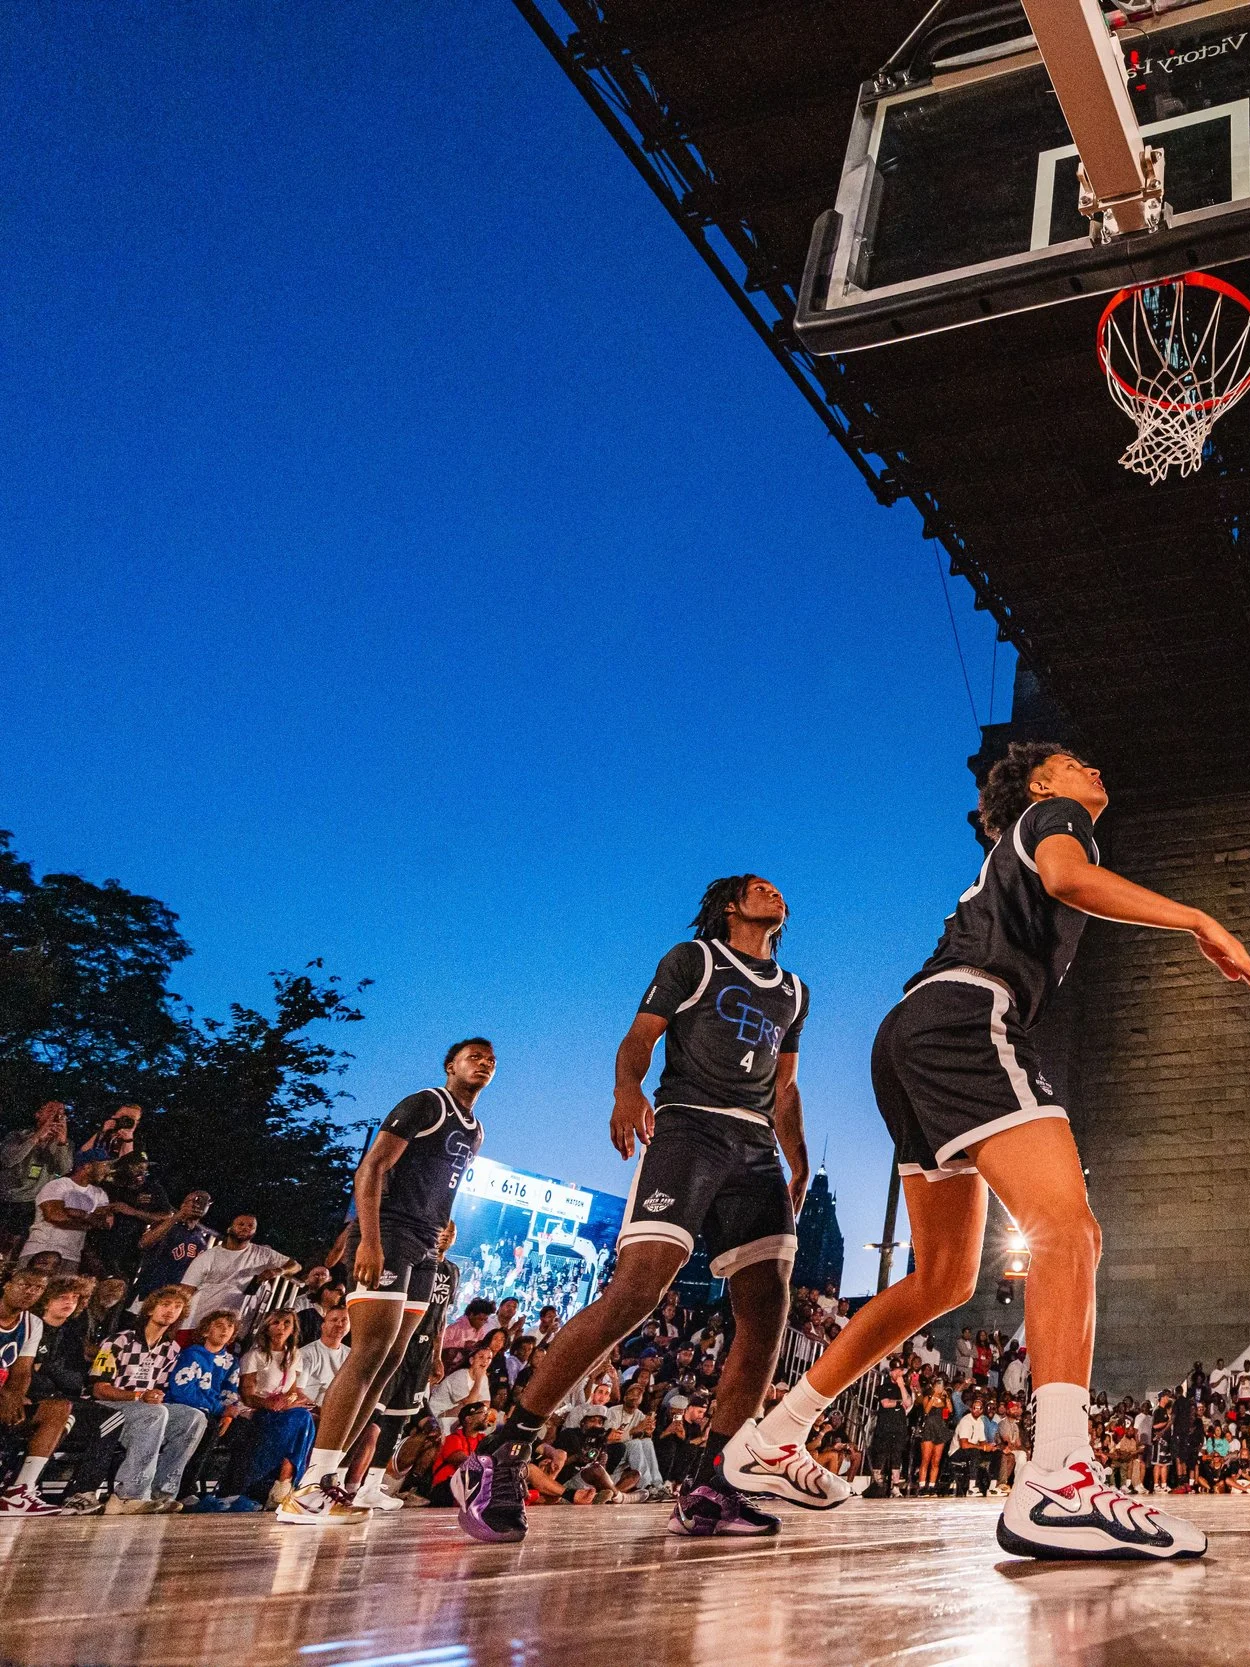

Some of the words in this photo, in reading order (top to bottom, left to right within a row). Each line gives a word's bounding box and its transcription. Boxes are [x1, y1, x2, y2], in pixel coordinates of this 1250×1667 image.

[740, 1050, 755, 1073] 4
[448, 1172, 460, 1189] 5
[501, 1179, 527, 1197] 6:16
[544, 1190, 552, 1203] 0
[171, 1243, 198, 1261] US
[434, 1274, 450, 1284] NY
[433, 1284, 450, 1295] VS
[431, 1295, 449, 1305] NY
